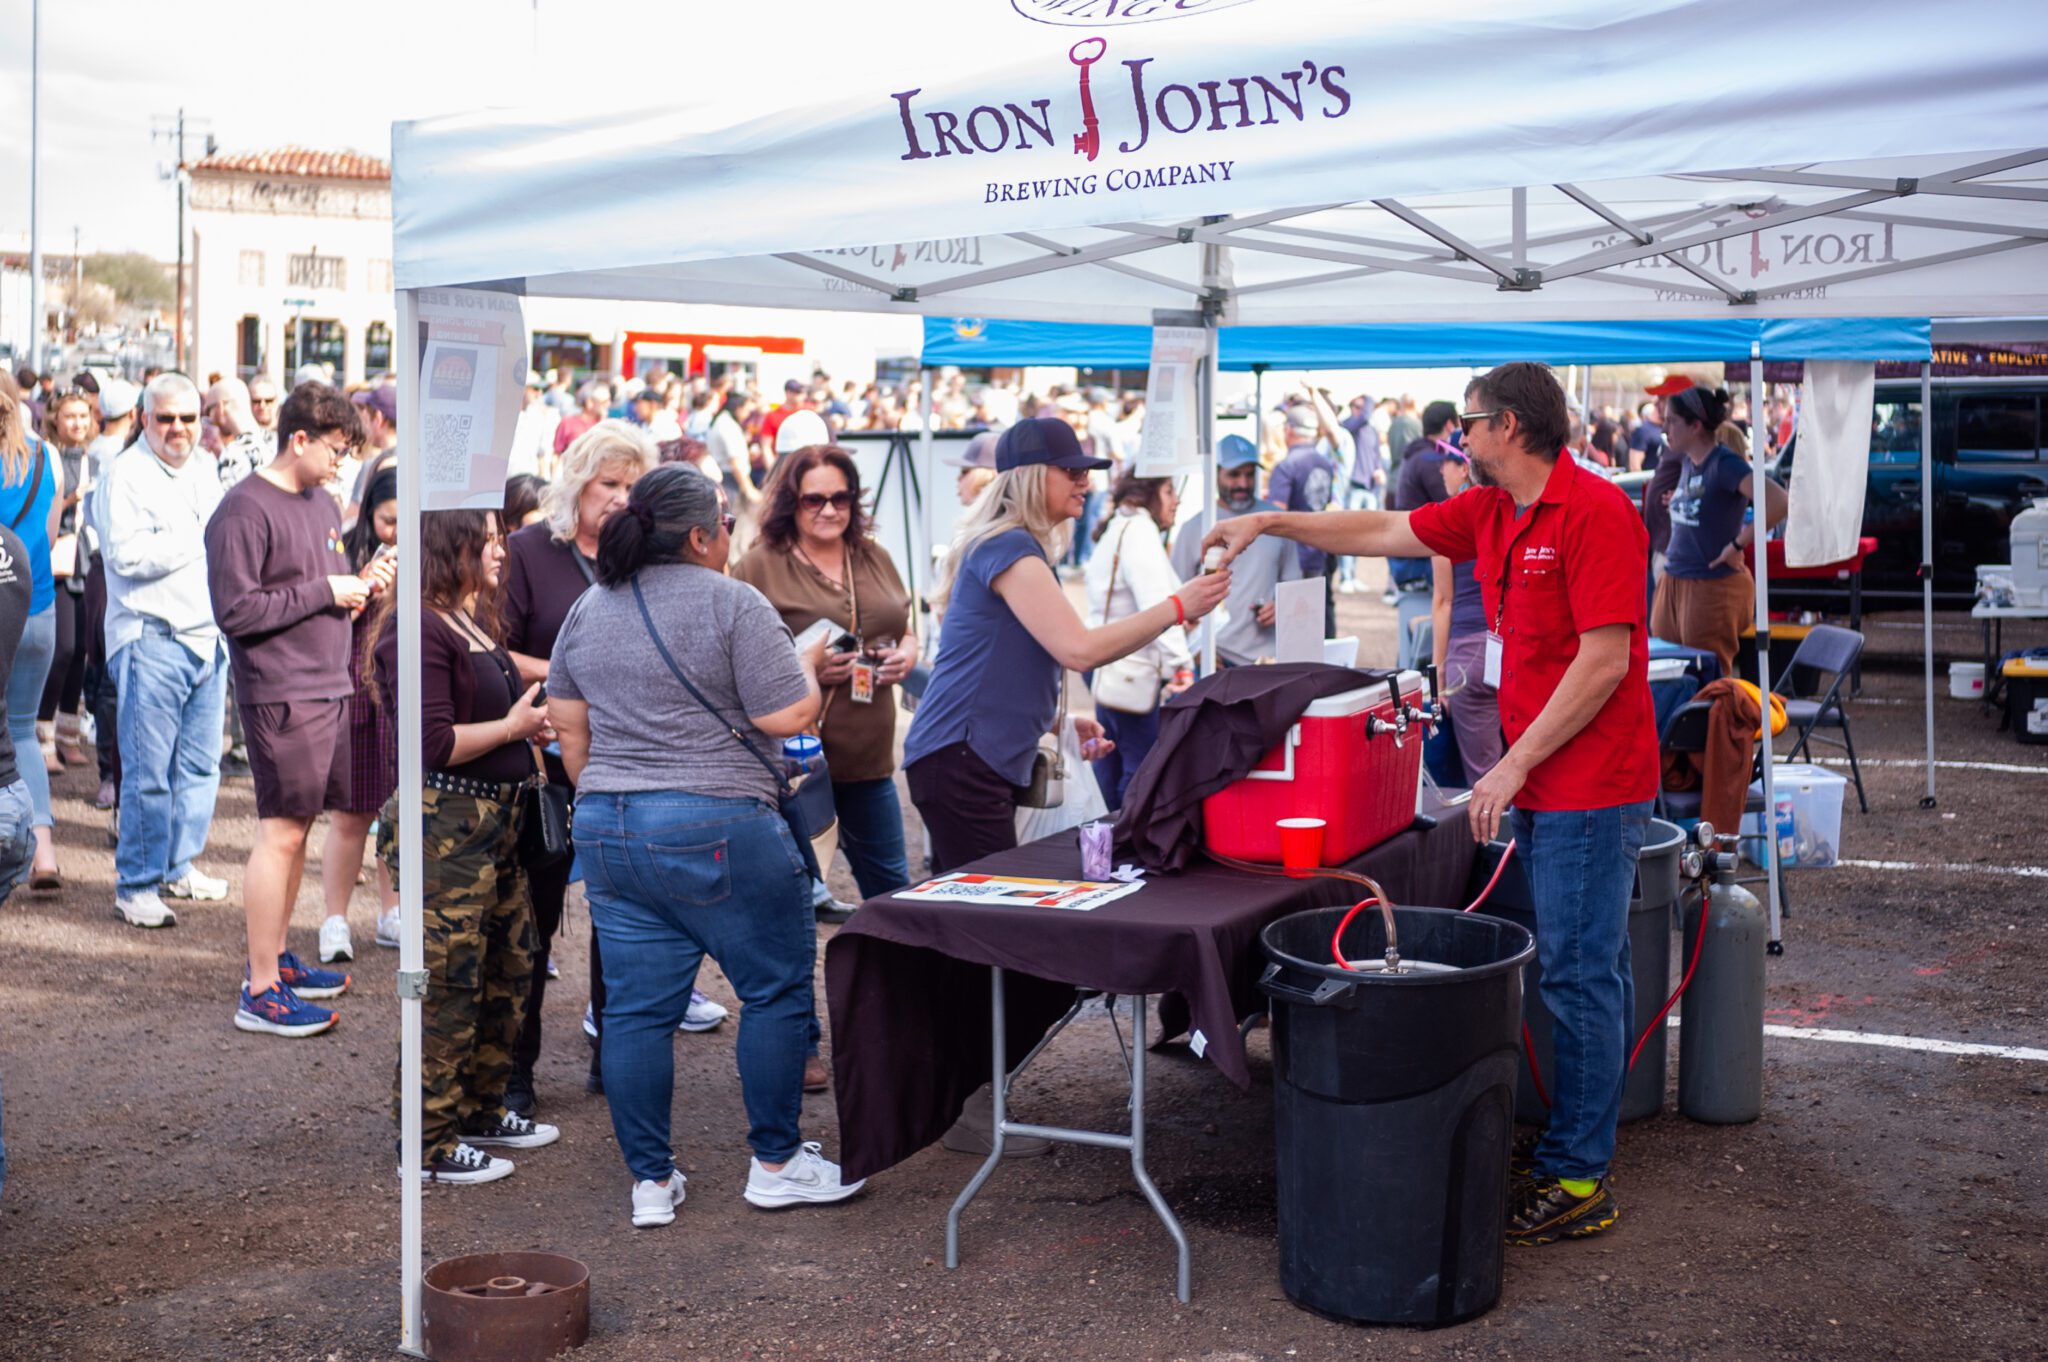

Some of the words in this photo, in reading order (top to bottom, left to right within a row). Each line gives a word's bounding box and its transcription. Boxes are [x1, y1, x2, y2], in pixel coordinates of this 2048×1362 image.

[891, 88, 1057, 160] IRON
[1118, 58, 1352, 153] JOHN'S
[985, 174, 1098, 203] BREWING
[1106, 161, 1235, 192] COMPANY
[1932, 350, 1968, 365] ATIVE
[1989, 351, 2048, 366] EMPLOYE
